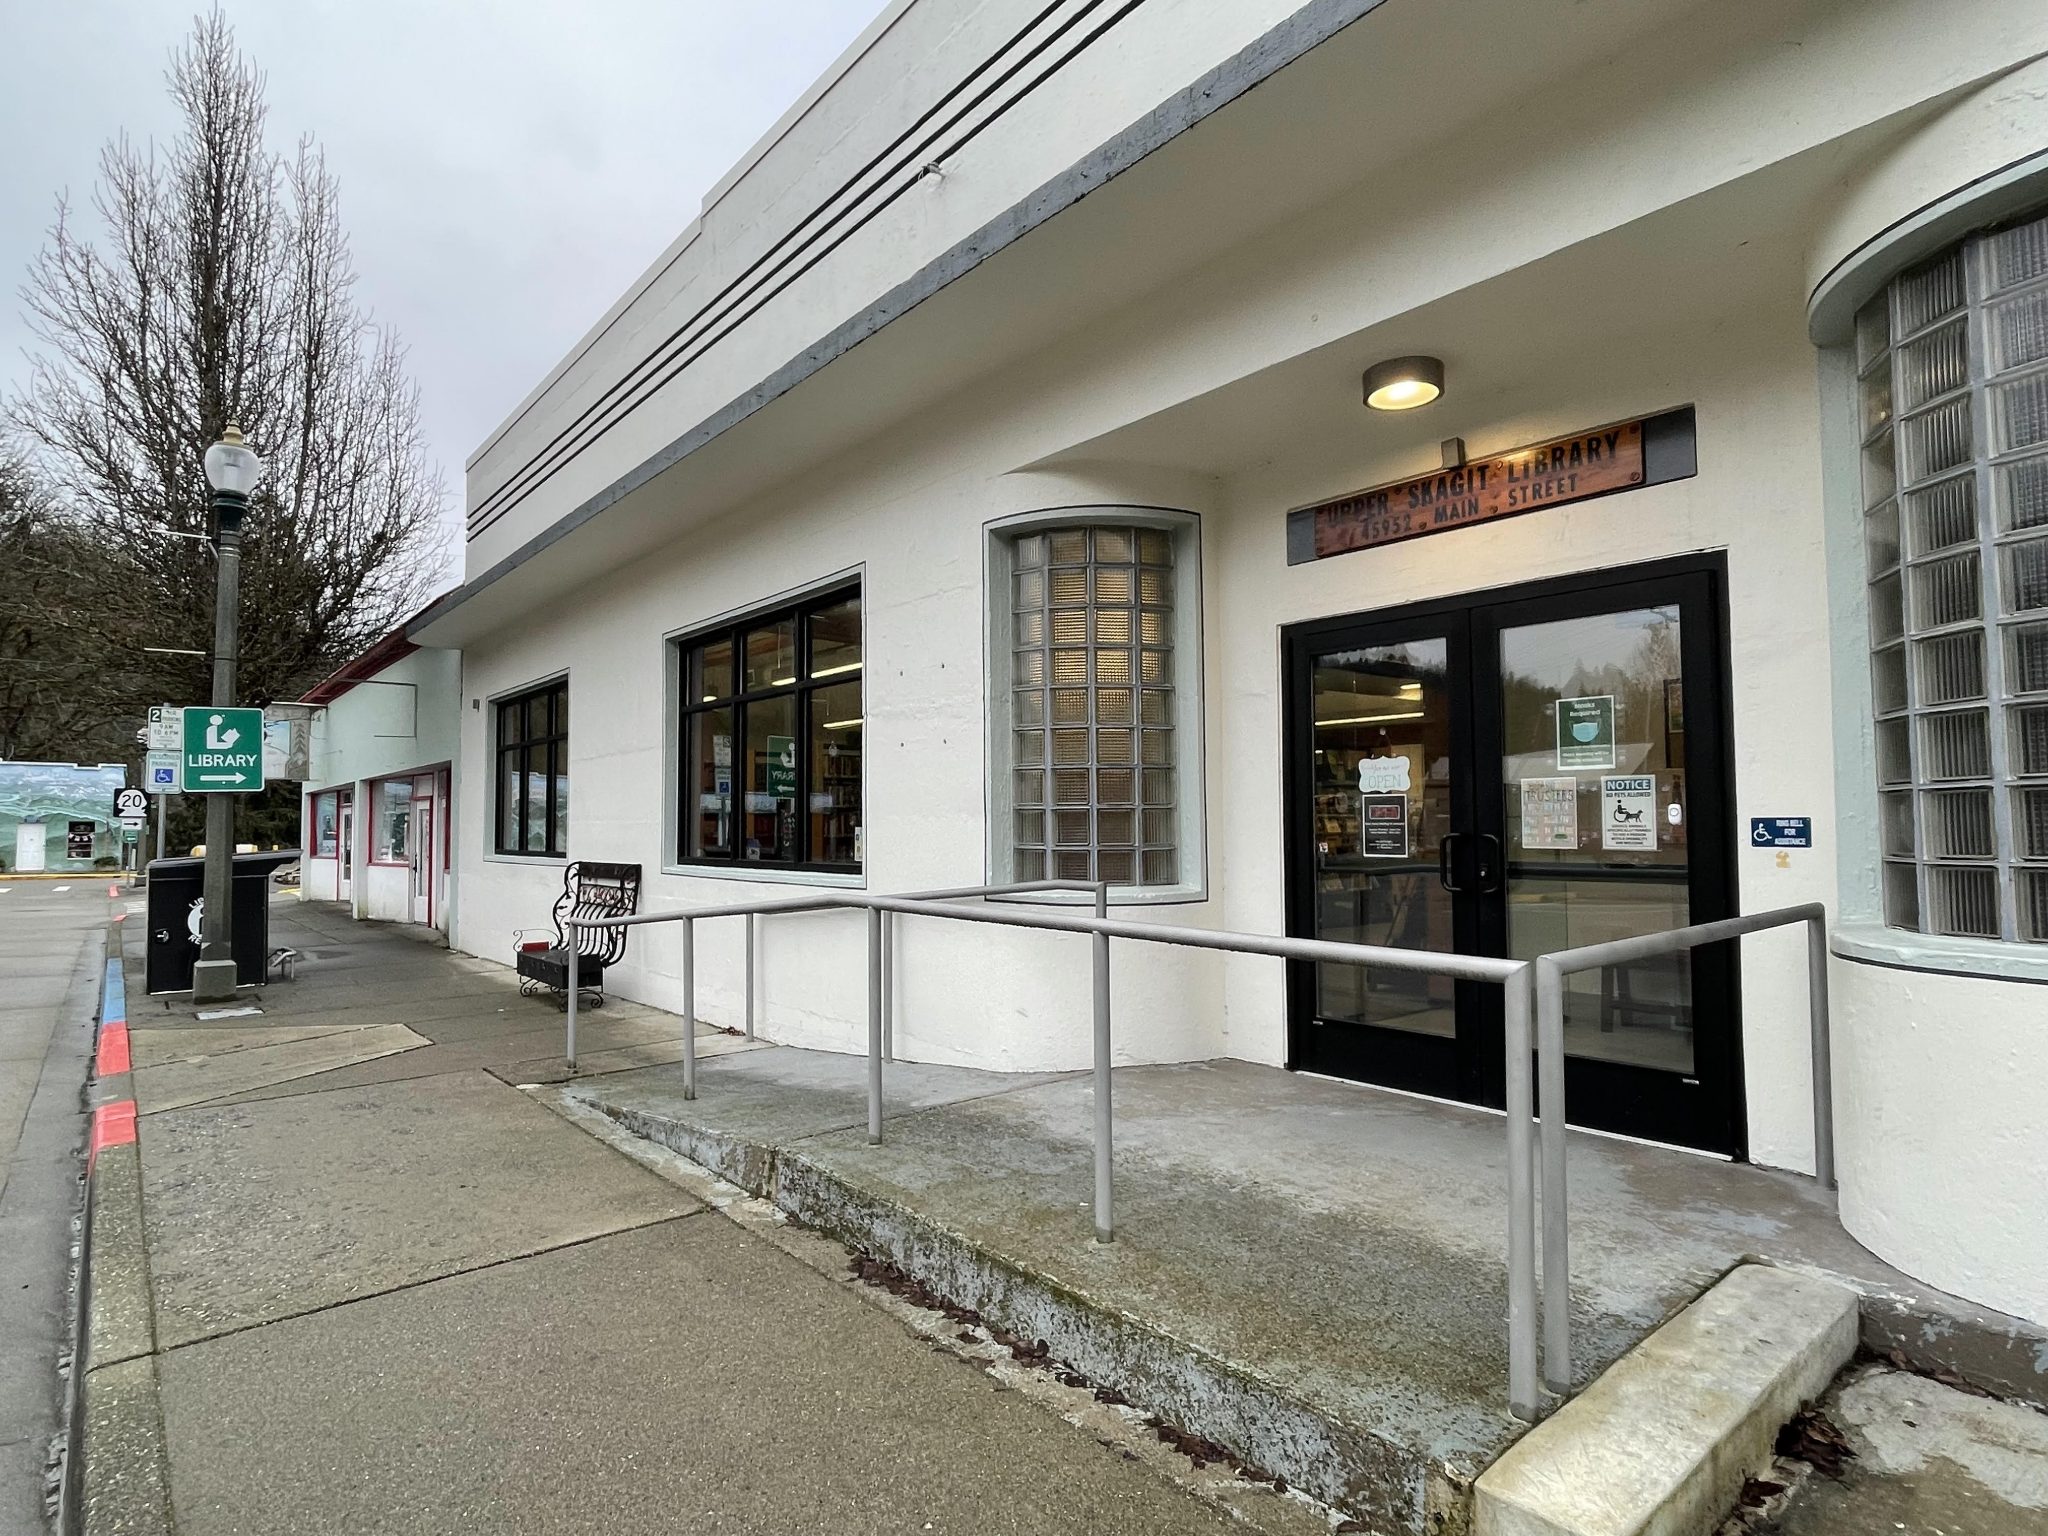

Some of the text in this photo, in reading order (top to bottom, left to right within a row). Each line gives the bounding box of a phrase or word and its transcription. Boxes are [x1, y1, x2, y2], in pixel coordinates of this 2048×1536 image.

[1326, 431, 1621, 528] UPPER SKAGIT LIBRARY
[1434, 498, 1479, 524] MAIN
[1507, 473, 1578, 507] STREET
[151, 709, 161, 721] 2
[188, 754, 258, 767] LIBRARY
[1368, 774, 1402, 789] OPEN
[1606, 780, 1650, 790] NOTICE
[121, 794, 142, 808] 20
